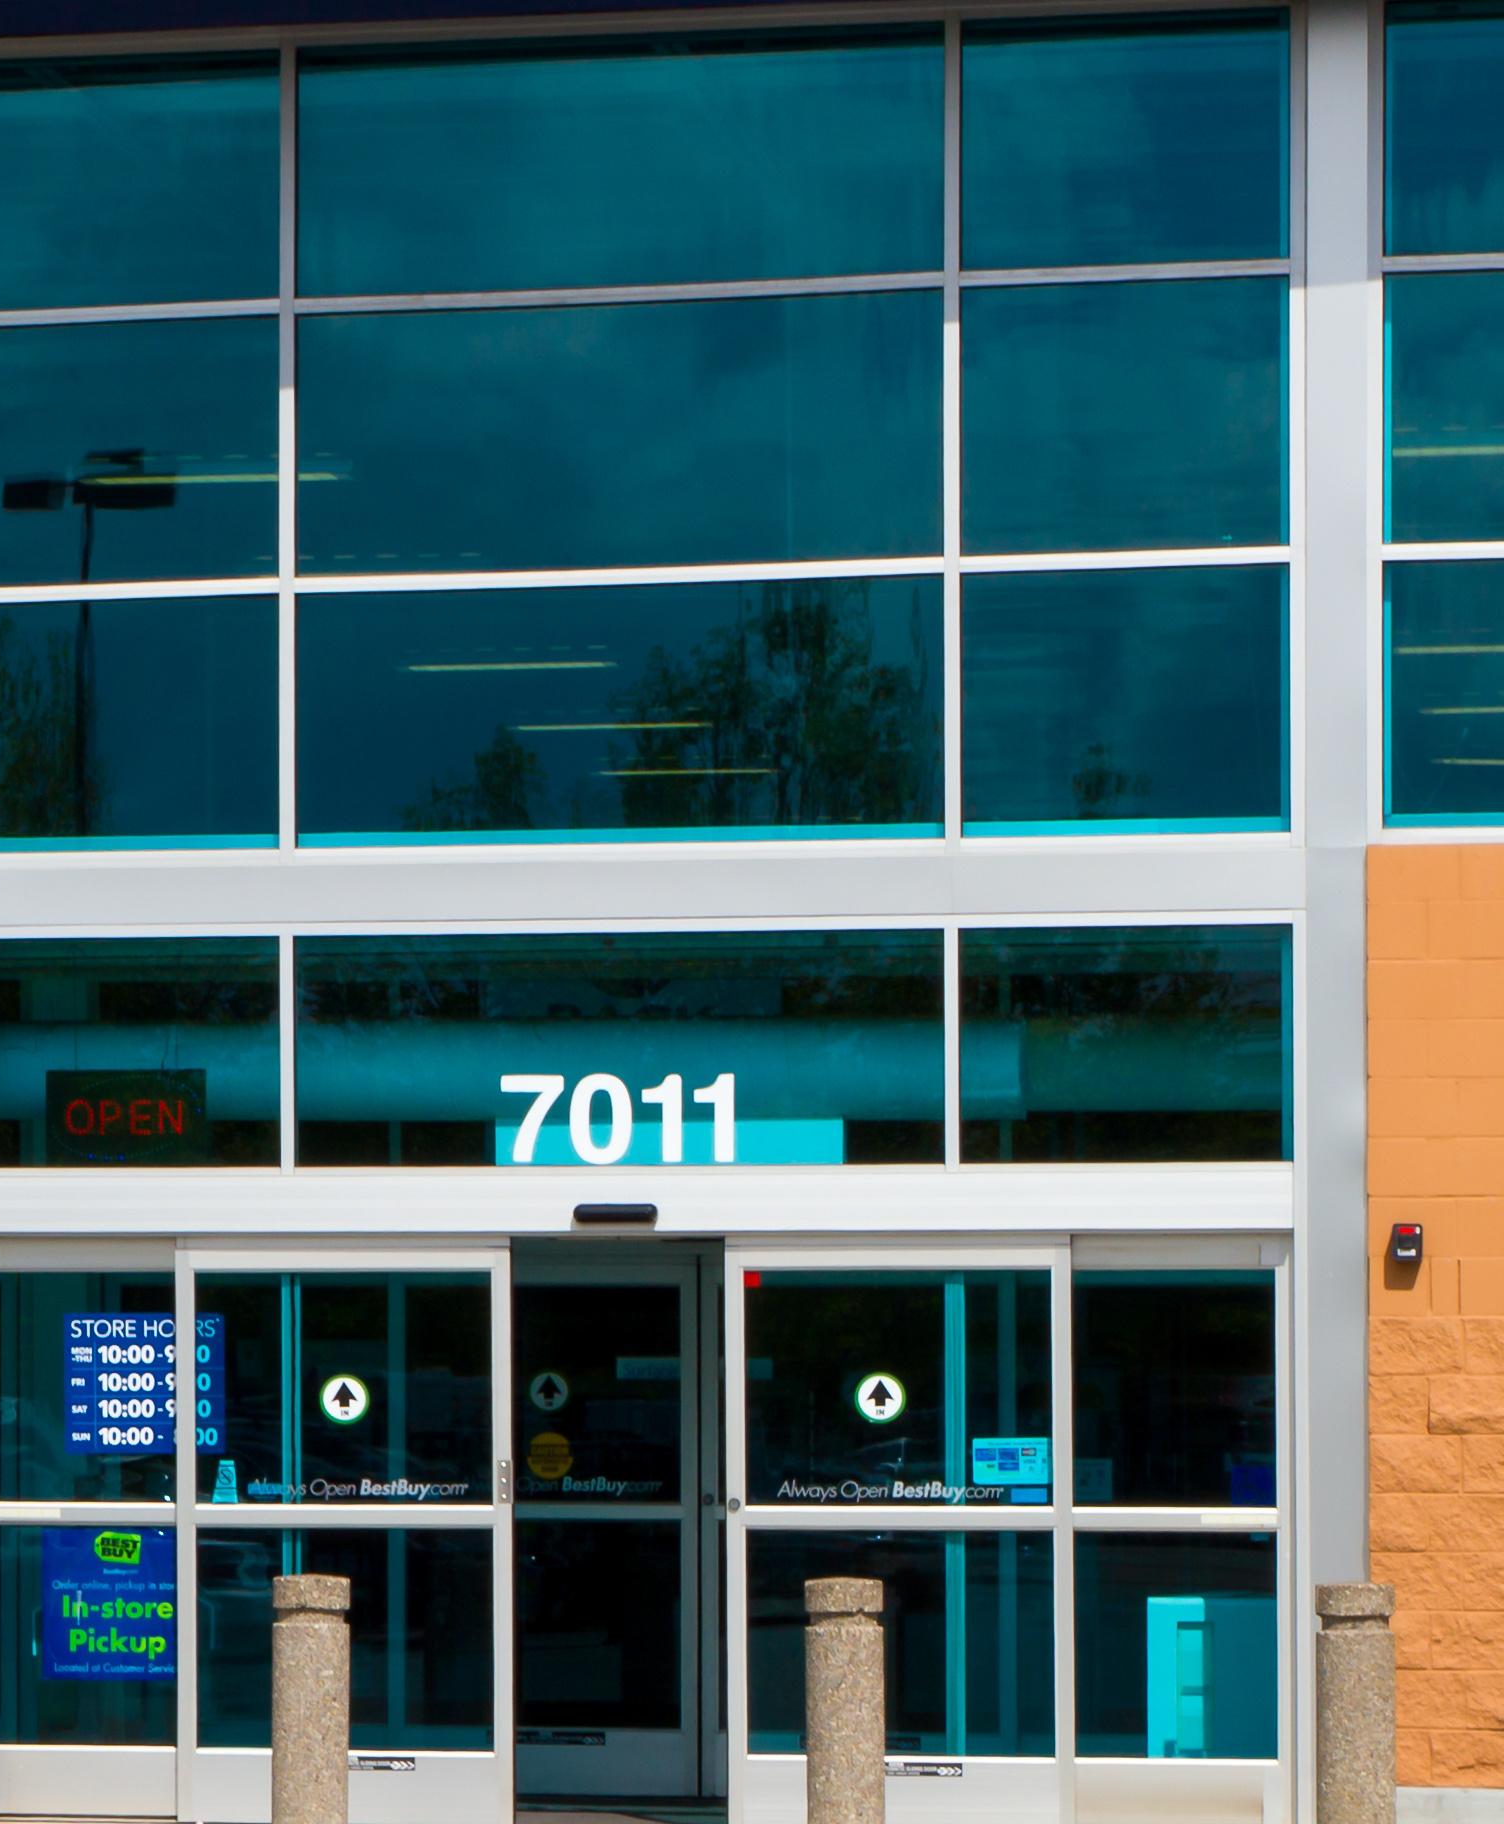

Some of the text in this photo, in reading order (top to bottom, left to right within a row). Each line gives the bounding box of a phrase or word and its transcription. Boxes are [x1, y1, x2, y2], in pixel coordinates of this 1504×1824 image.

[65, 1098, 184, 1136] OPEN
[500, 1072, 735, 1165] 7011
[70, 1319, 137, 1339] STORE
[71, 1347, 93, 1355] MON
[71, 1378, 86, 1387] FRI
[71, 1405, 88, 1414] SAT
[72, 1432, 91, 1441] SUN
[310, 1478, 356, 1500] Open
[777, 1480, 837, 1503] Always
[841, 1481, 888, 1503] Open
[100, 1537, 139, 1550] BEST
[101, 1547, 136, 1559] BUY
[52, 1579, 78, 1590] Order
[115, 1579, 145, 1592] pickup
[62, 1595, 174, 1619] In-store
[69, 1627, 167, 1660] Pickup
[54, 1662, 89, 1672] Located
[148, 1662, 174, 1673] Servic
